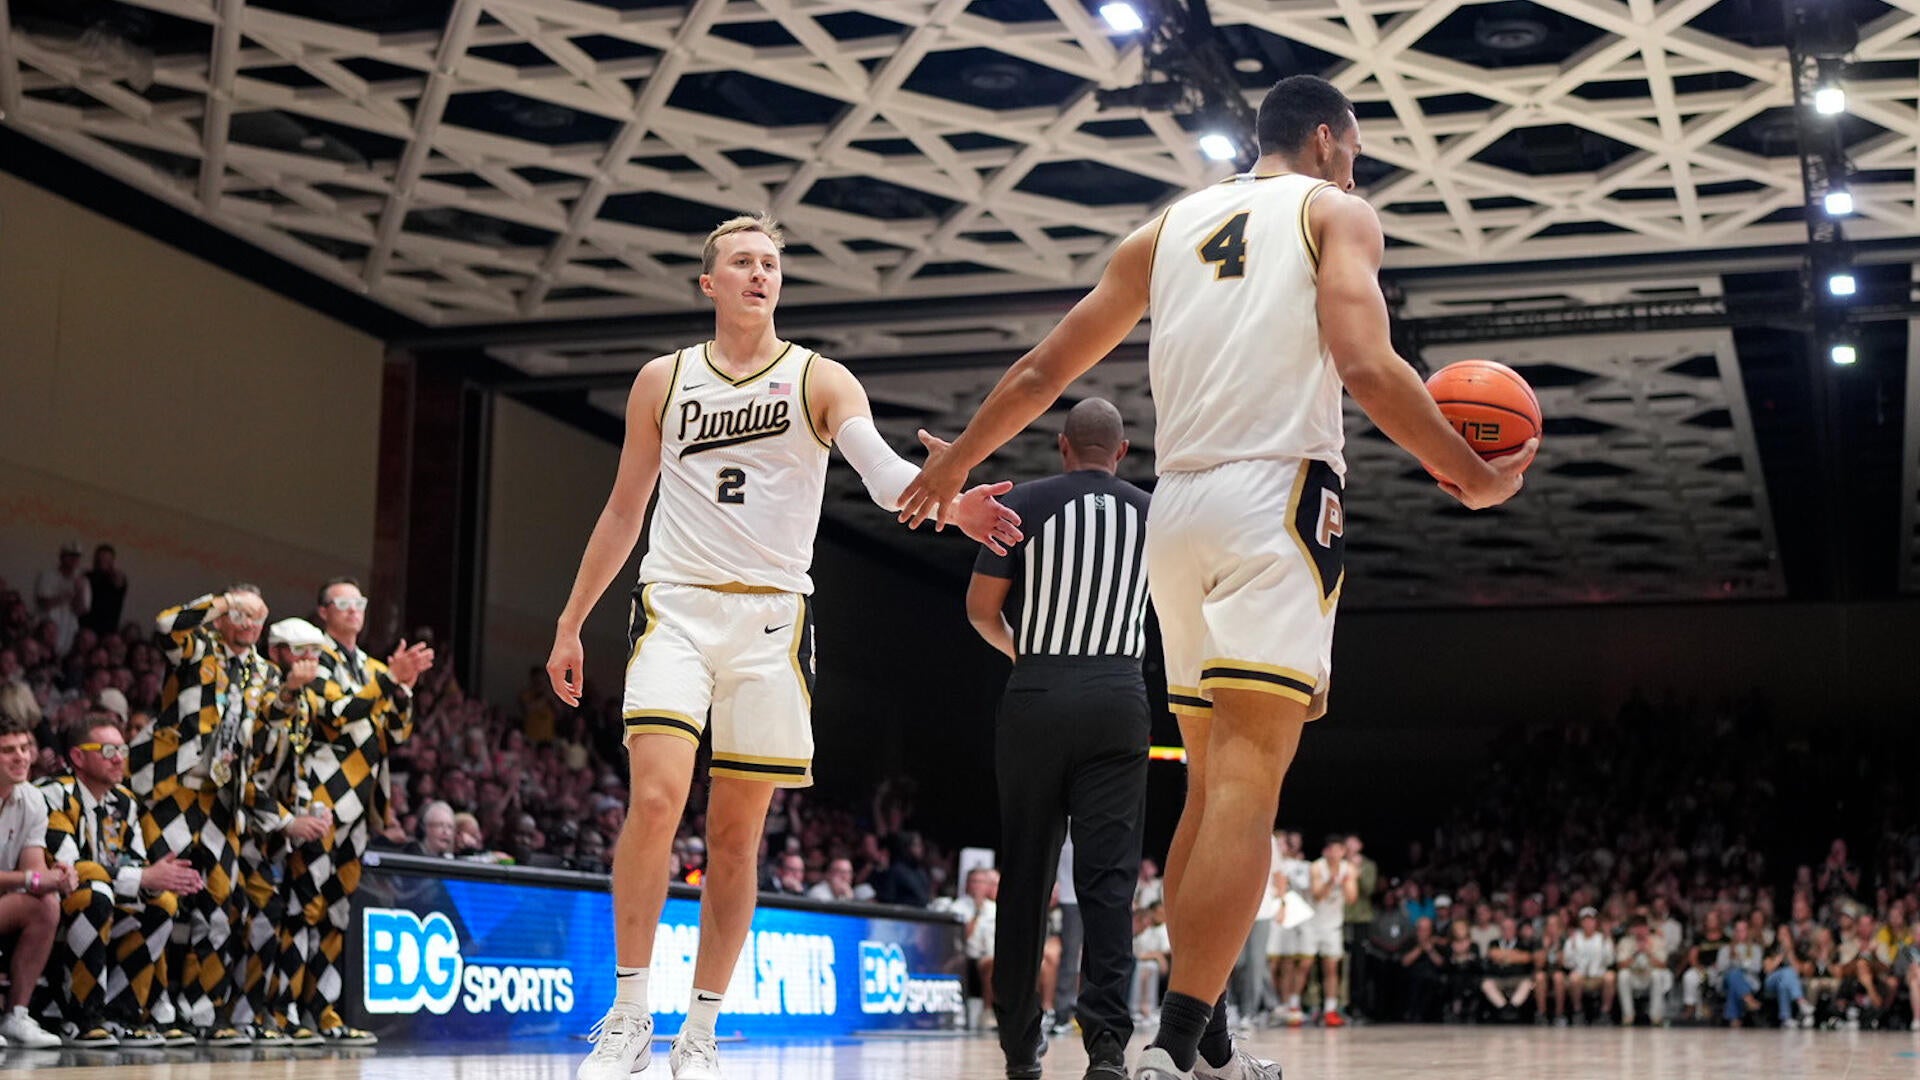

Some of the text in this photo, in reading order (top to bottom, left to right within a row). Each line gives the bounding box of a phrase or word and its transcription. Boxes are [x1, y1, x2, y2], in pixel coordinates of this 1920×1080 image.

[1197, 210, 1252, 282] 4
[678, 398, 792, 448] Purdue
[716, 466, 746, 505] 2
[1315, 487, 1344, 548] P
[365, 908, 574, 1013] BDG SPORTS
